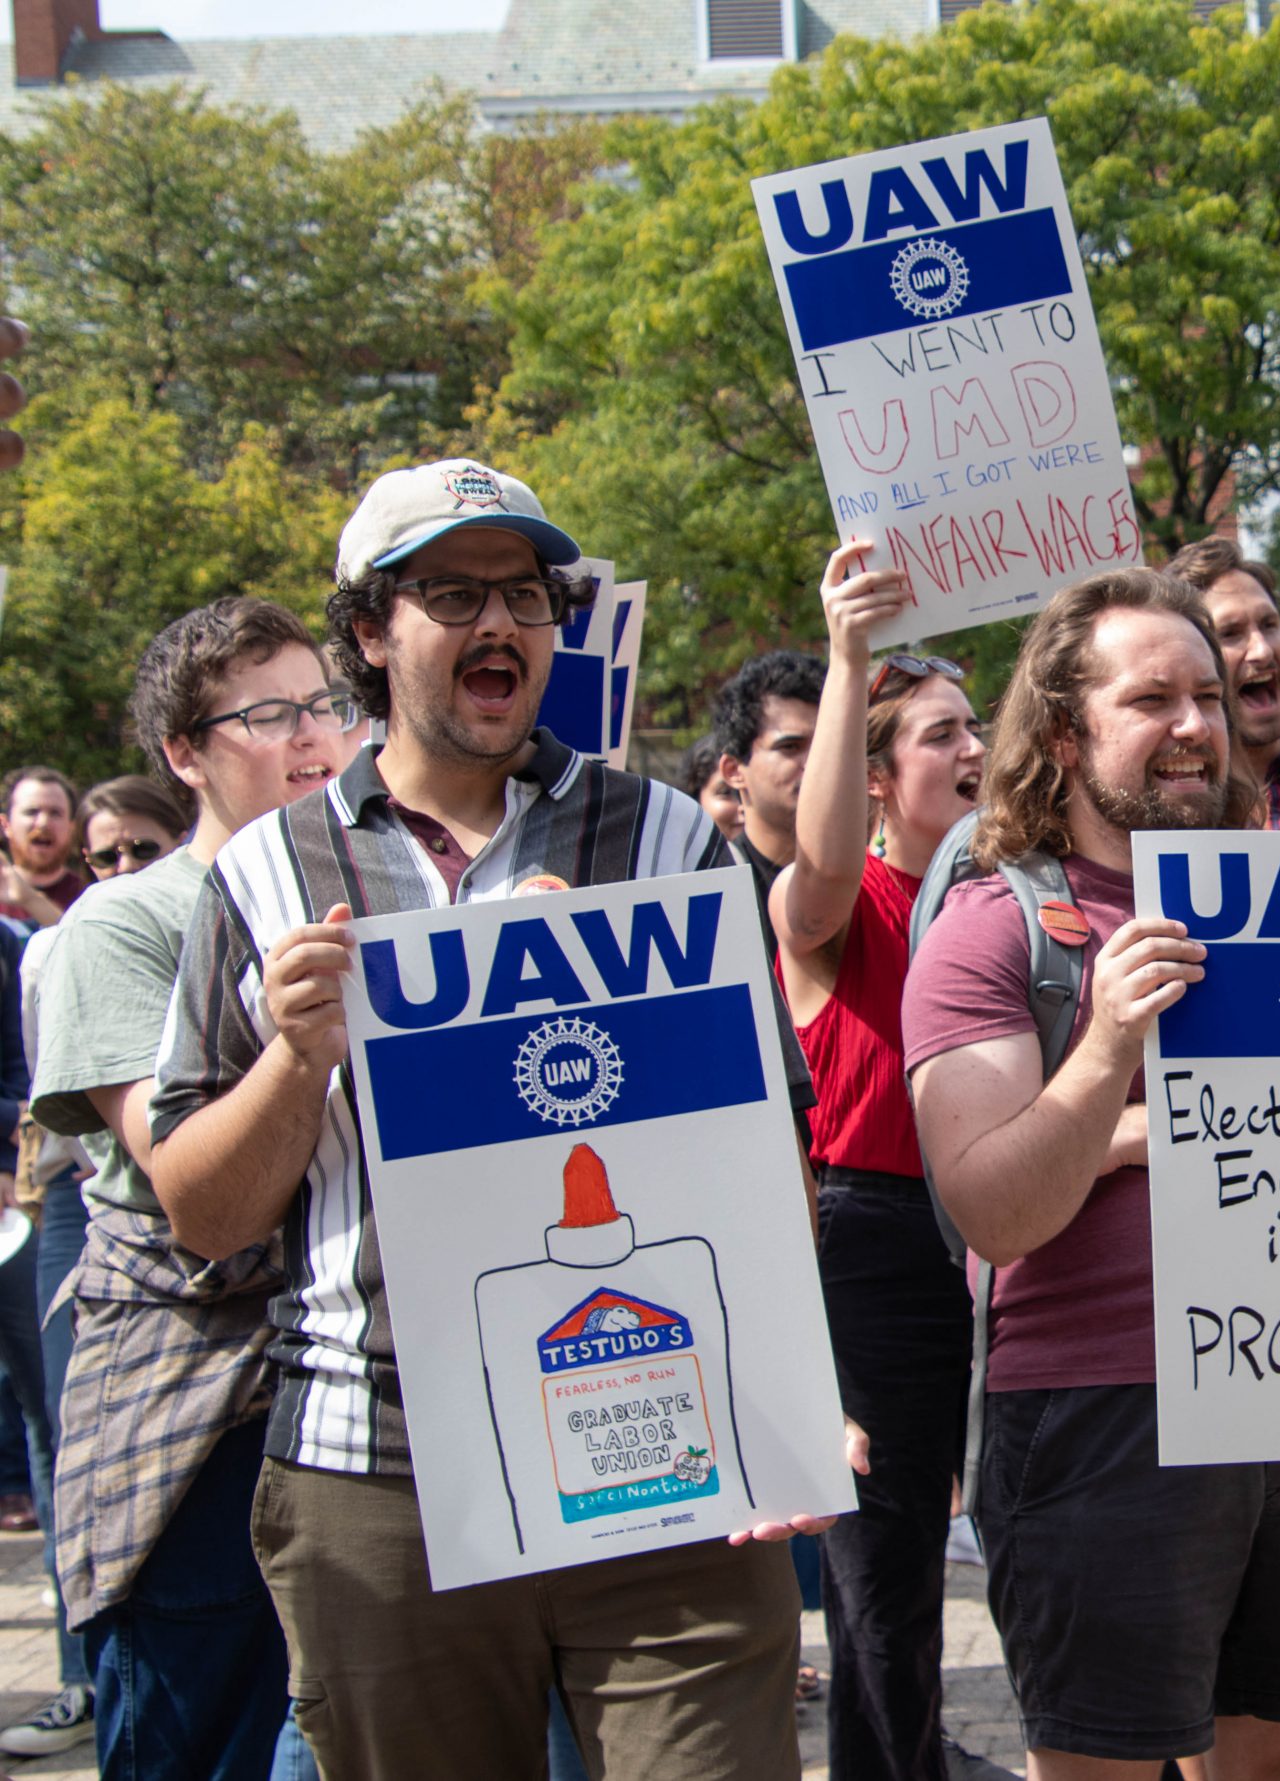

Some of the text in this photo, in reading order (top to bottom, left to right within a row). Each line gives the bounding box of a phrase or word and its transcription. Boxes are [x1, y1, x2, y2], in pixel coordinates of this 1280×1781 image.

[773, 140, 1029, 254] UAW
[912, 267, 946, 290] UAW
[801, 302, 1075, 397] I WENT TO
[838, 361, 1077, 475] UMD
[837, 442, 1105, 522] AND ALL I GOT WERE
[360, 892, 724, 1029] UAW
[544, 1057, 591, 1086] UAW
[542, 1325, 684, 1366] TESTUDO'S
[555, 1368, 676, 1399] FEARLESS, NO RUN
[568, 1393, 694, 1433] GRADUATE
[585, 1419, 677, 1452] LABOR
[592, 1444, 671, 1476] UNION
